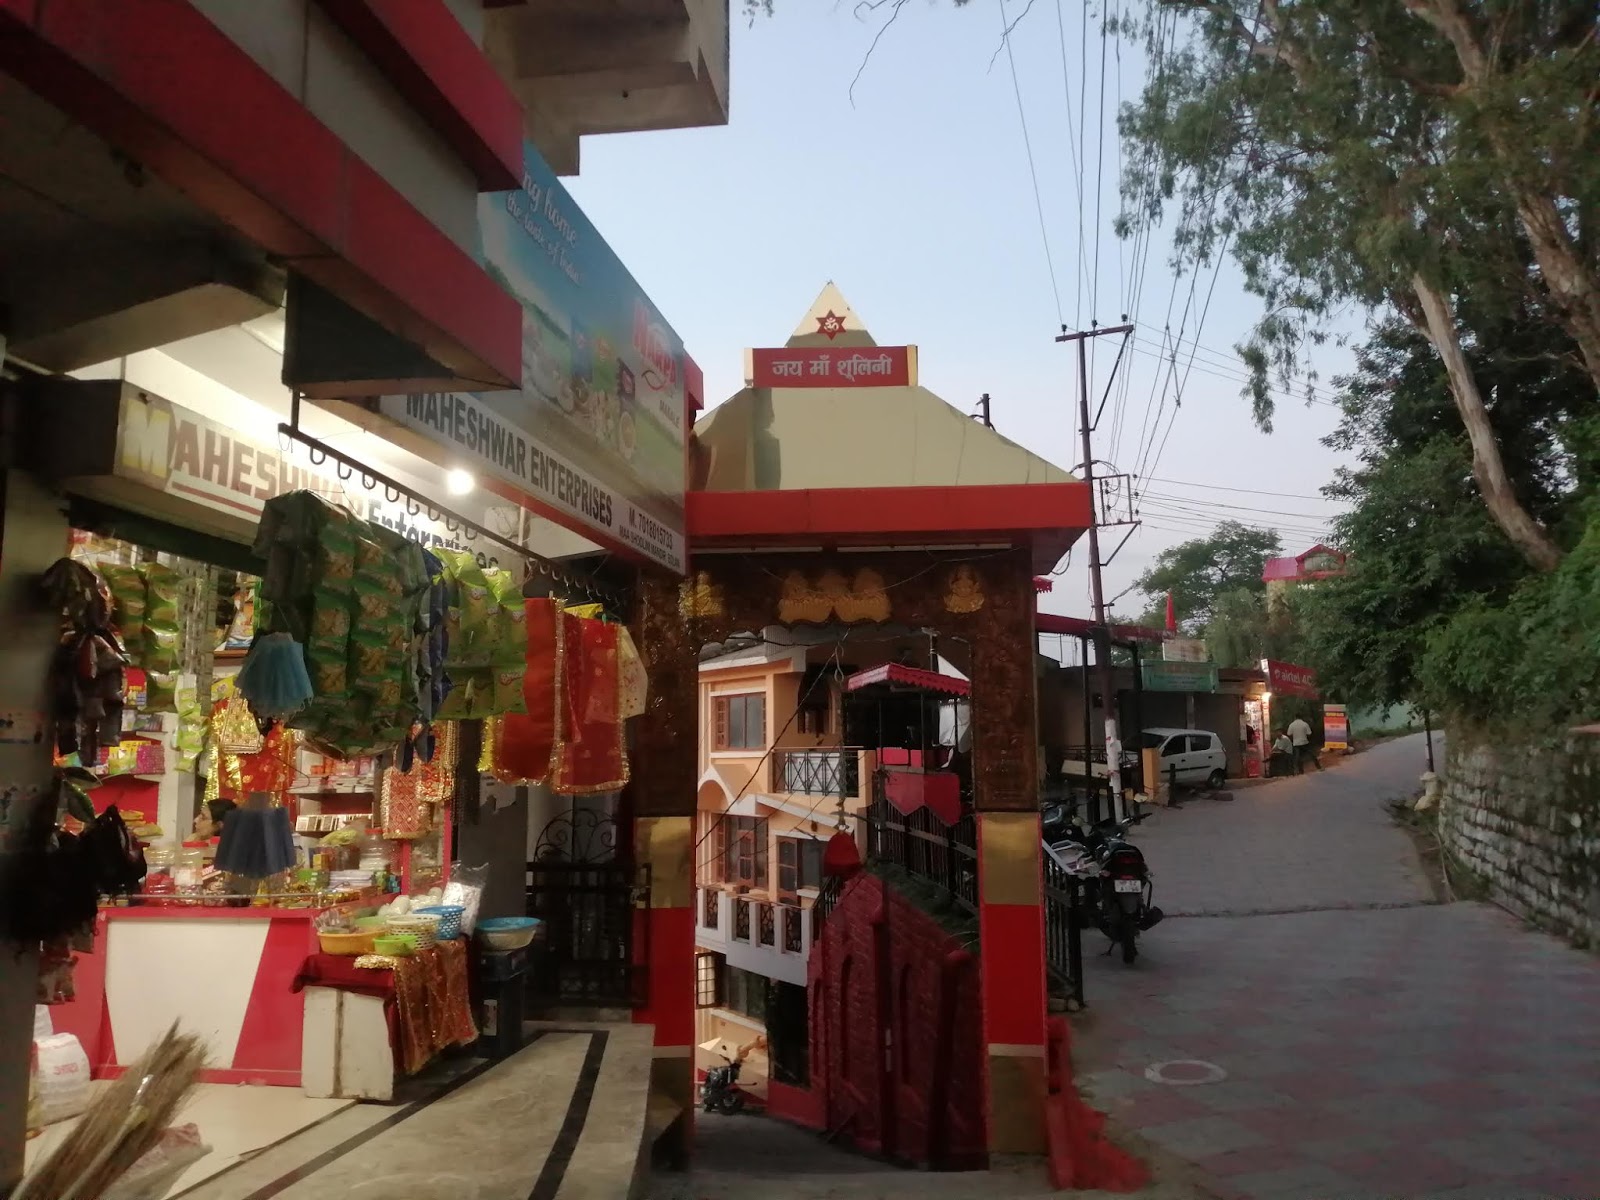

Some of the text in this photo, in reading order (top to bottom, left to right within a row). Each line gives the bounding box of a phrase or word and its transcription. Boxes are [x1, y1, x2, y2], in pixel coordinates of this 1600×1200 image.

[544, 187, 577, 249] home
[772, 354, 893, 382] जय माँ शूलिनी
[406, 392, 613, 528] MAHESHWAR ENTERPRISES
[368, 500, 499, 569] Enterpries
[1281, 670, 1300, 684] airtel
